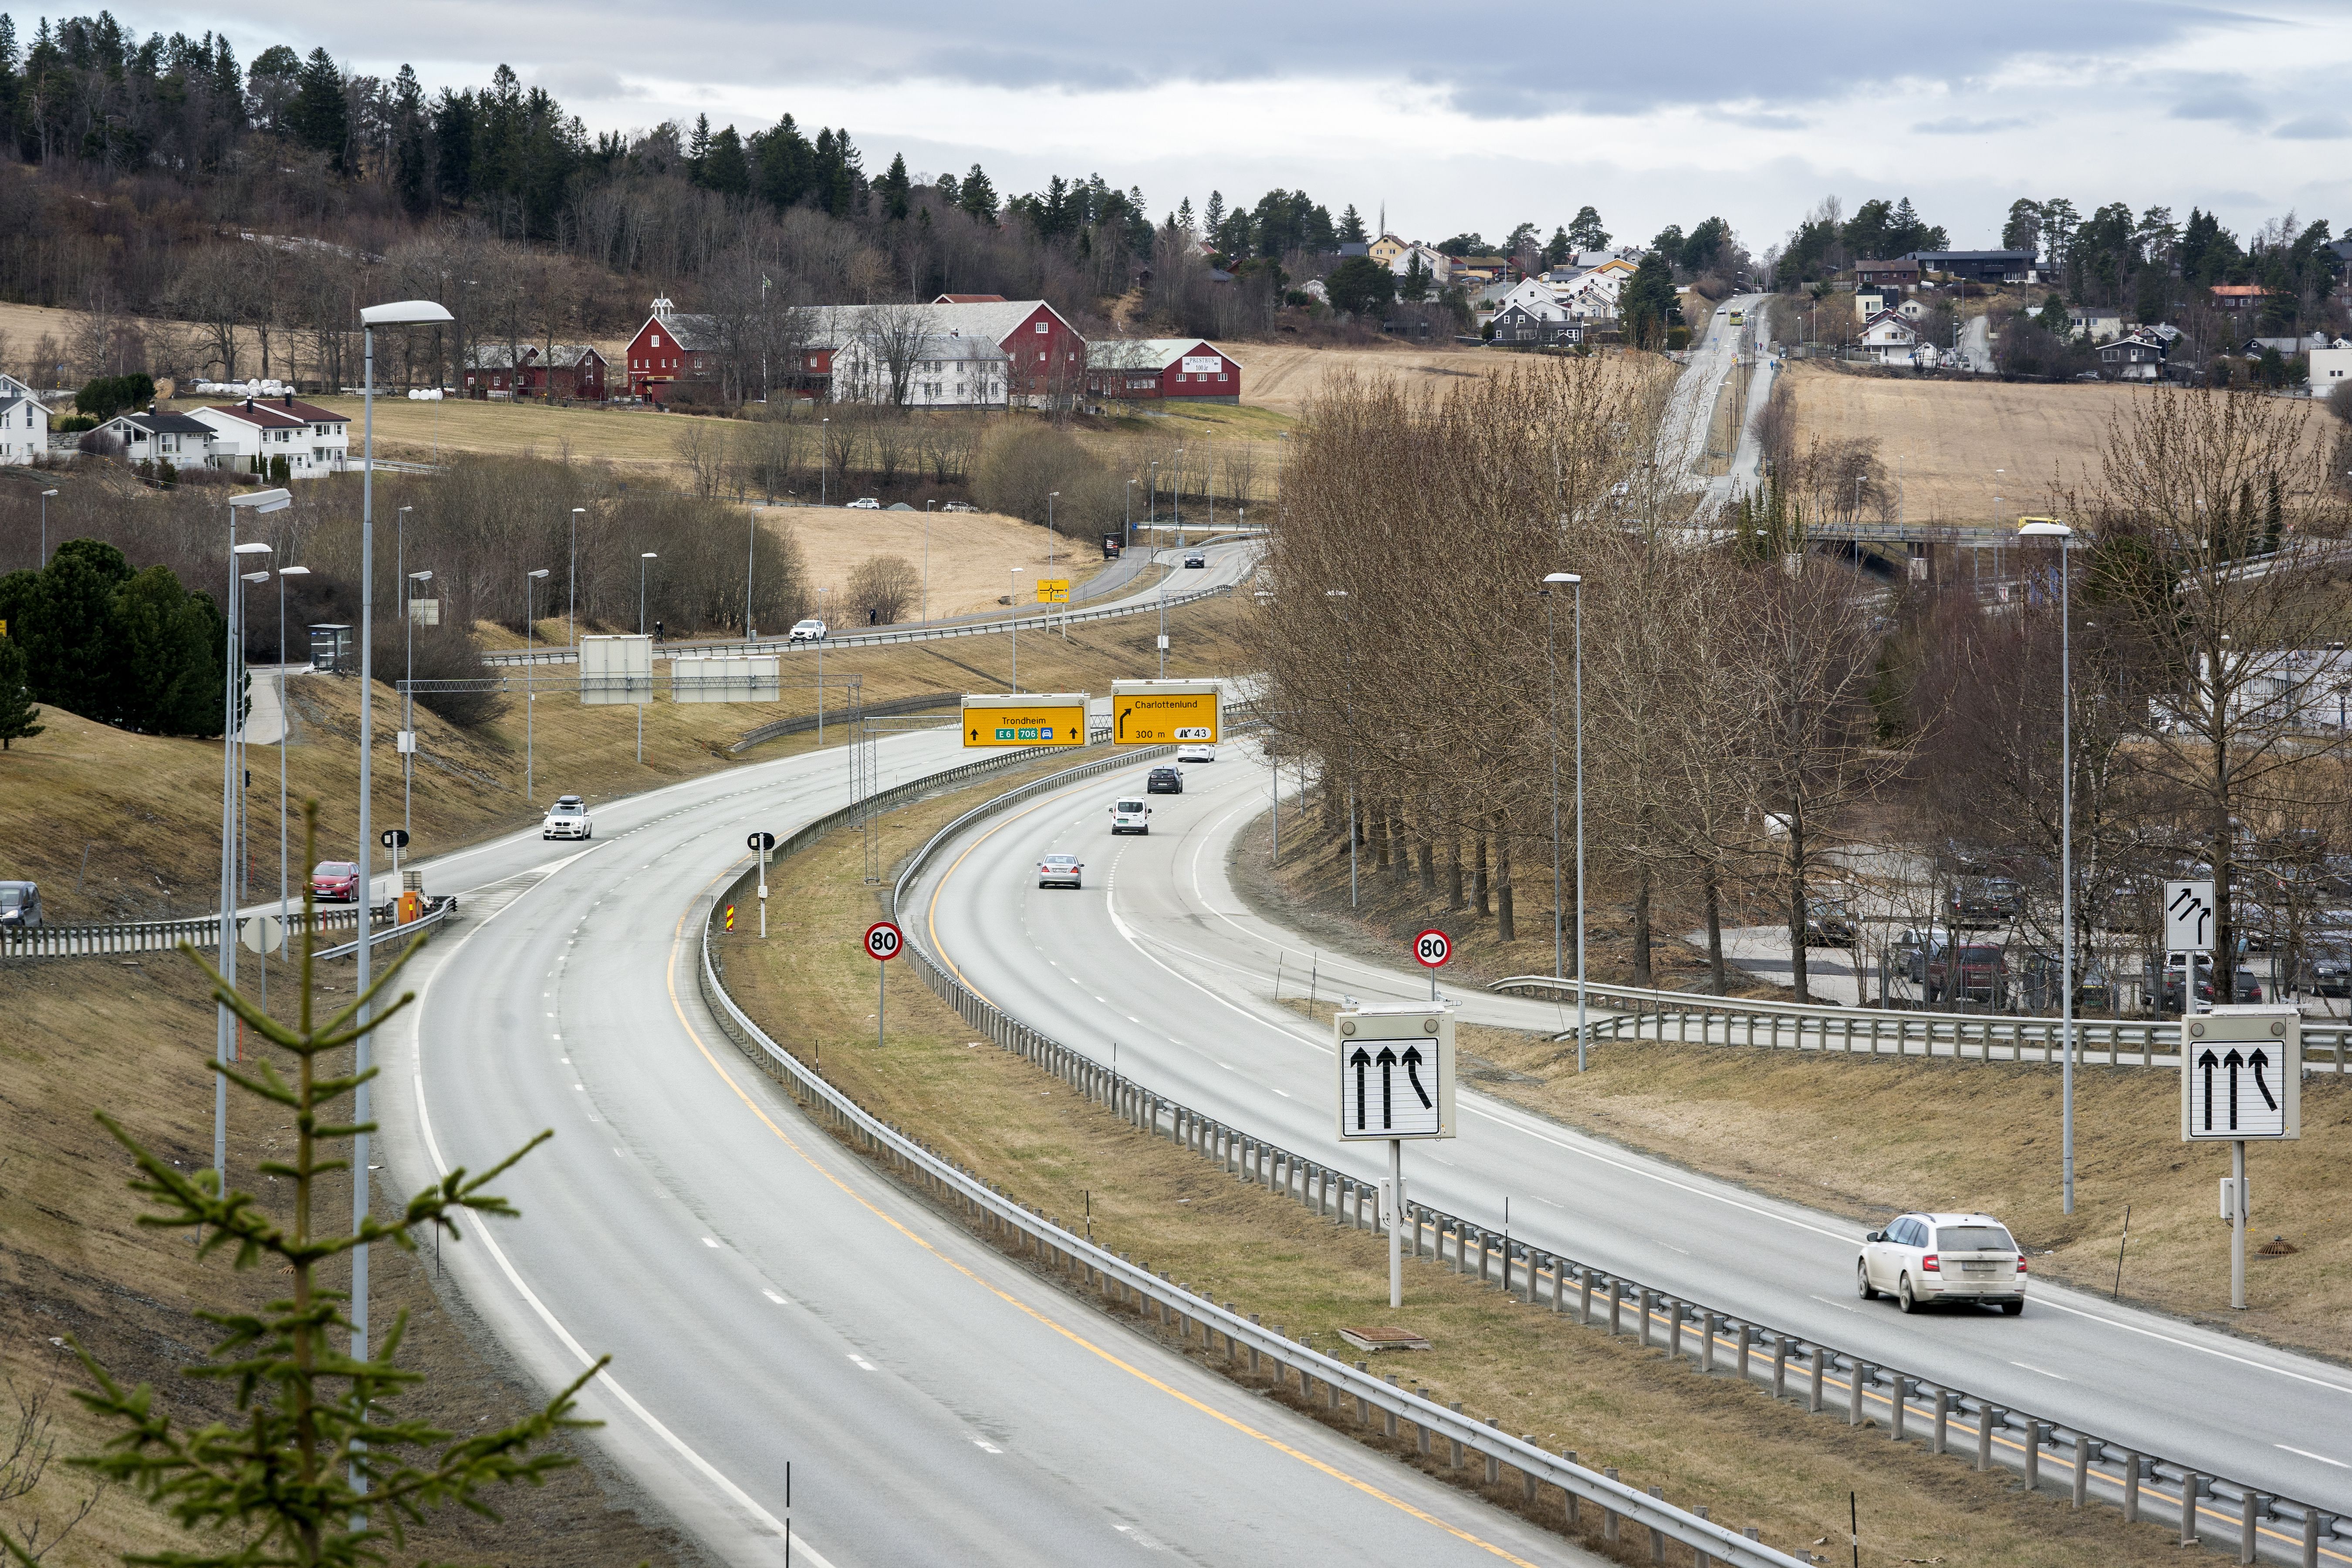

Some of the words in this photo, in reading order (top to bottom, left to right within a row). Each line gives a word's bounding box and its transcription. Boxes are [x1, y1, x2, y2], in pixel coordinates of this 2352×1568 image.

[1135, 700, 1197, 709] Charlottenlund
[1194, 729, 1206, 737] 43
[871, 932, 896, 950] 80
[1420, 939, 1445, 957] 80
